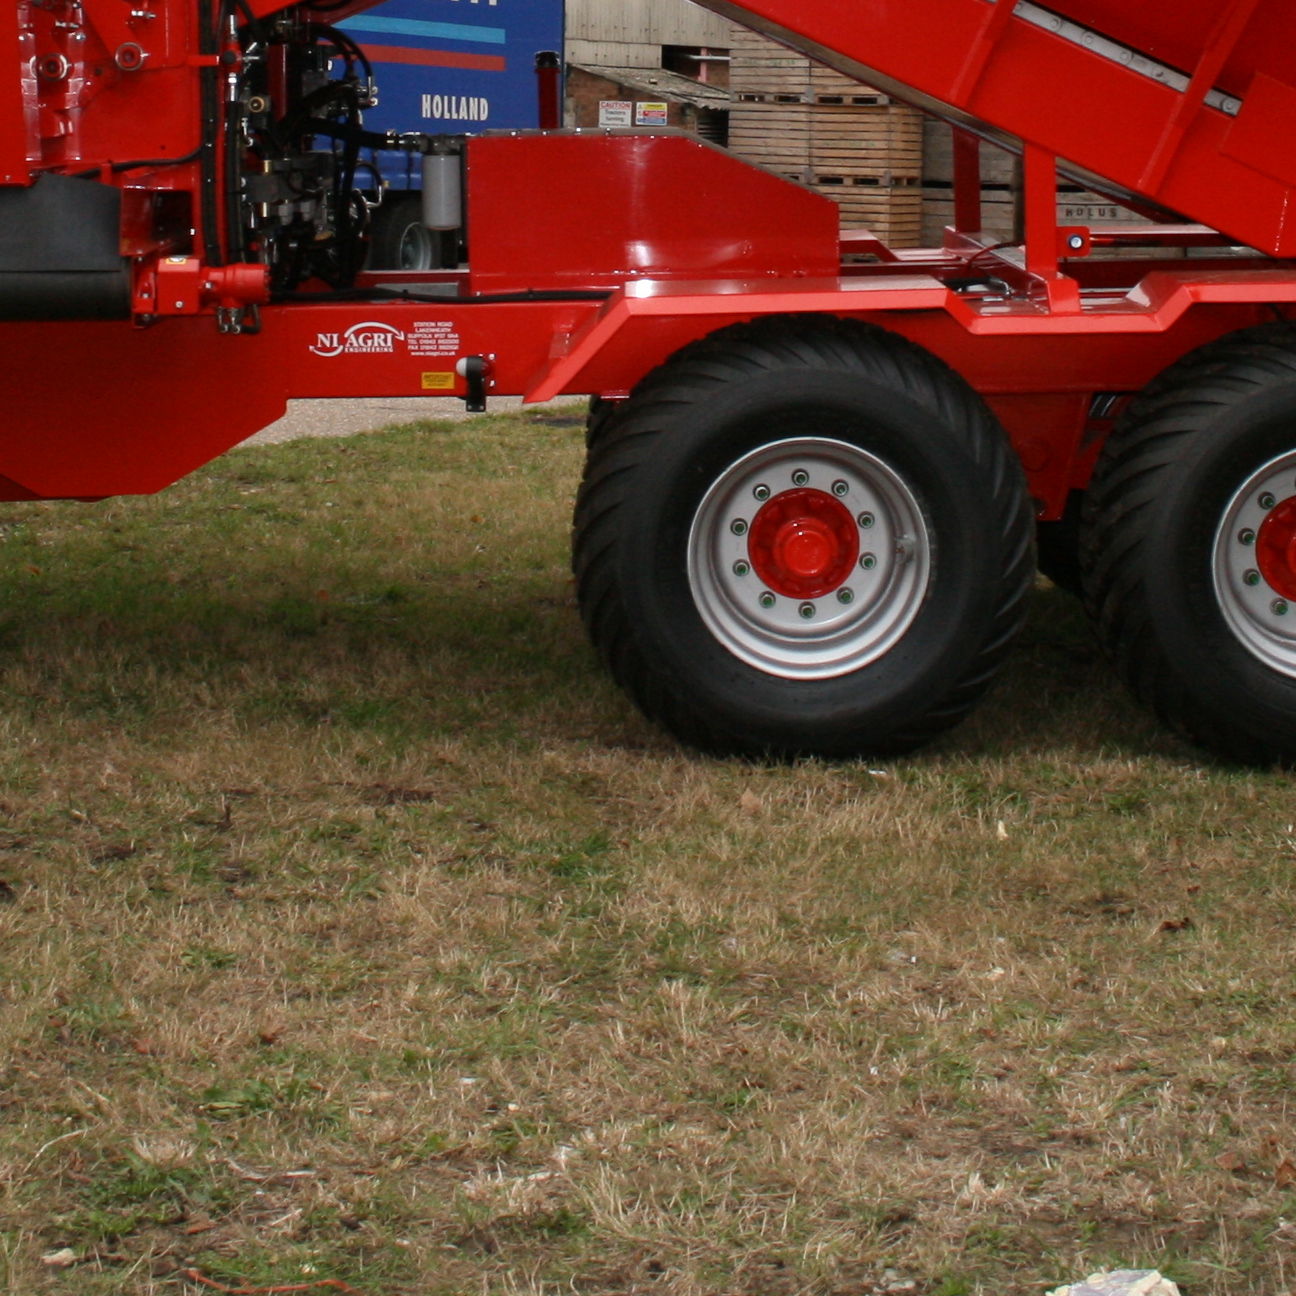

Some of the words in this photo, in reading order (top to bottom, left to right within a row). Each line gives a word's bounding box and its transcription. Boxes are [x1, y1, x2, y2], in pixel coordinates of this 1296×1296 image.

[421, 93, 489, 121] HOLLAND
[1065, 207, 1117, 218] HOLUS
[317, 333, 339, 348] NI
[345, 333, 394, 348] AGRI
